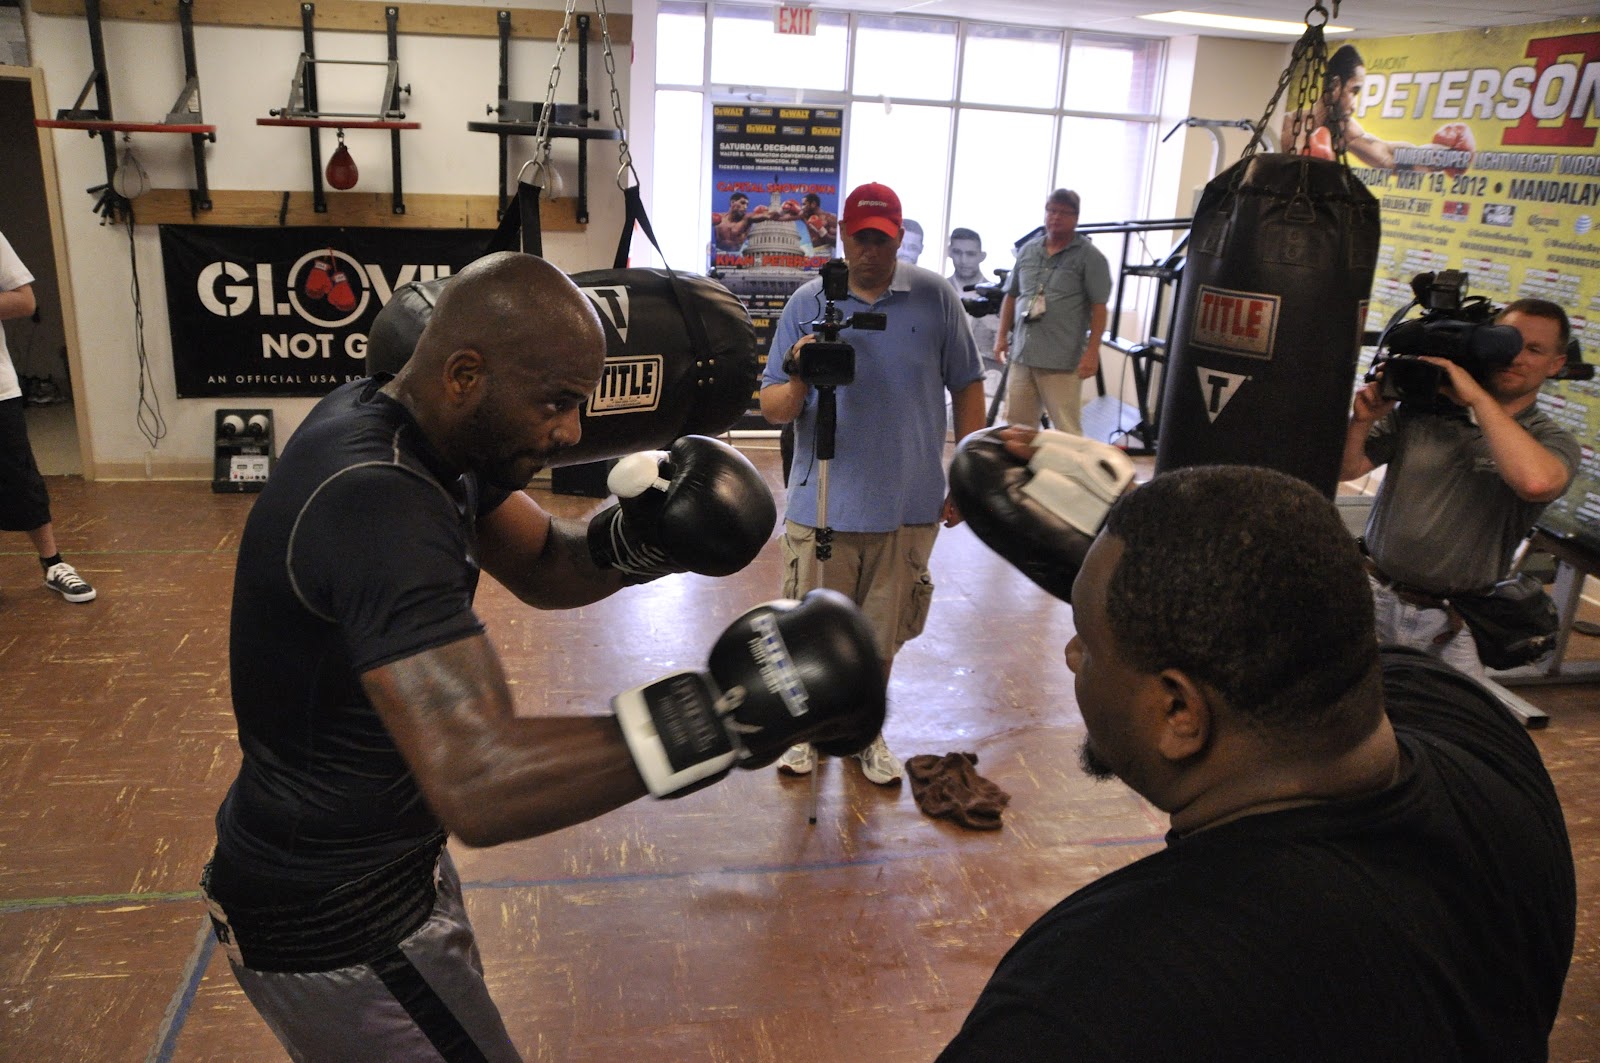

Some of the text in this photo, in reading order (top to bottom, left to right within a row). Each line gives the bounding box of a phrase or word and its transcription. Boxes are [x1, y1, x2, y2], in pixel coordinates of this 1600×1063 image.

[779, 7, 813, 34] EXIT
[720, 142, 762, 151] SATURDAY,
[763, 144, 806, 153] DECEMBER
[819, 145, 835, 153] 2011
[1473, 152, 1557, 174] LIGHTWEIGHT
[717, 181, 835, 195] CAPITAL SHOWDOWN
[1398, 169, 1425, 190] MAY
[1451, 174, 1488, 196] 2012
[716, 253, 754, 266] KHAN
[1201, 293, 1263, 338] TITLE
[262, 333, 333, 359] NOT
[207, 375, 369, 384] AN OFFICIAL USA BO
[600, 363, 653, 400] TITLE
